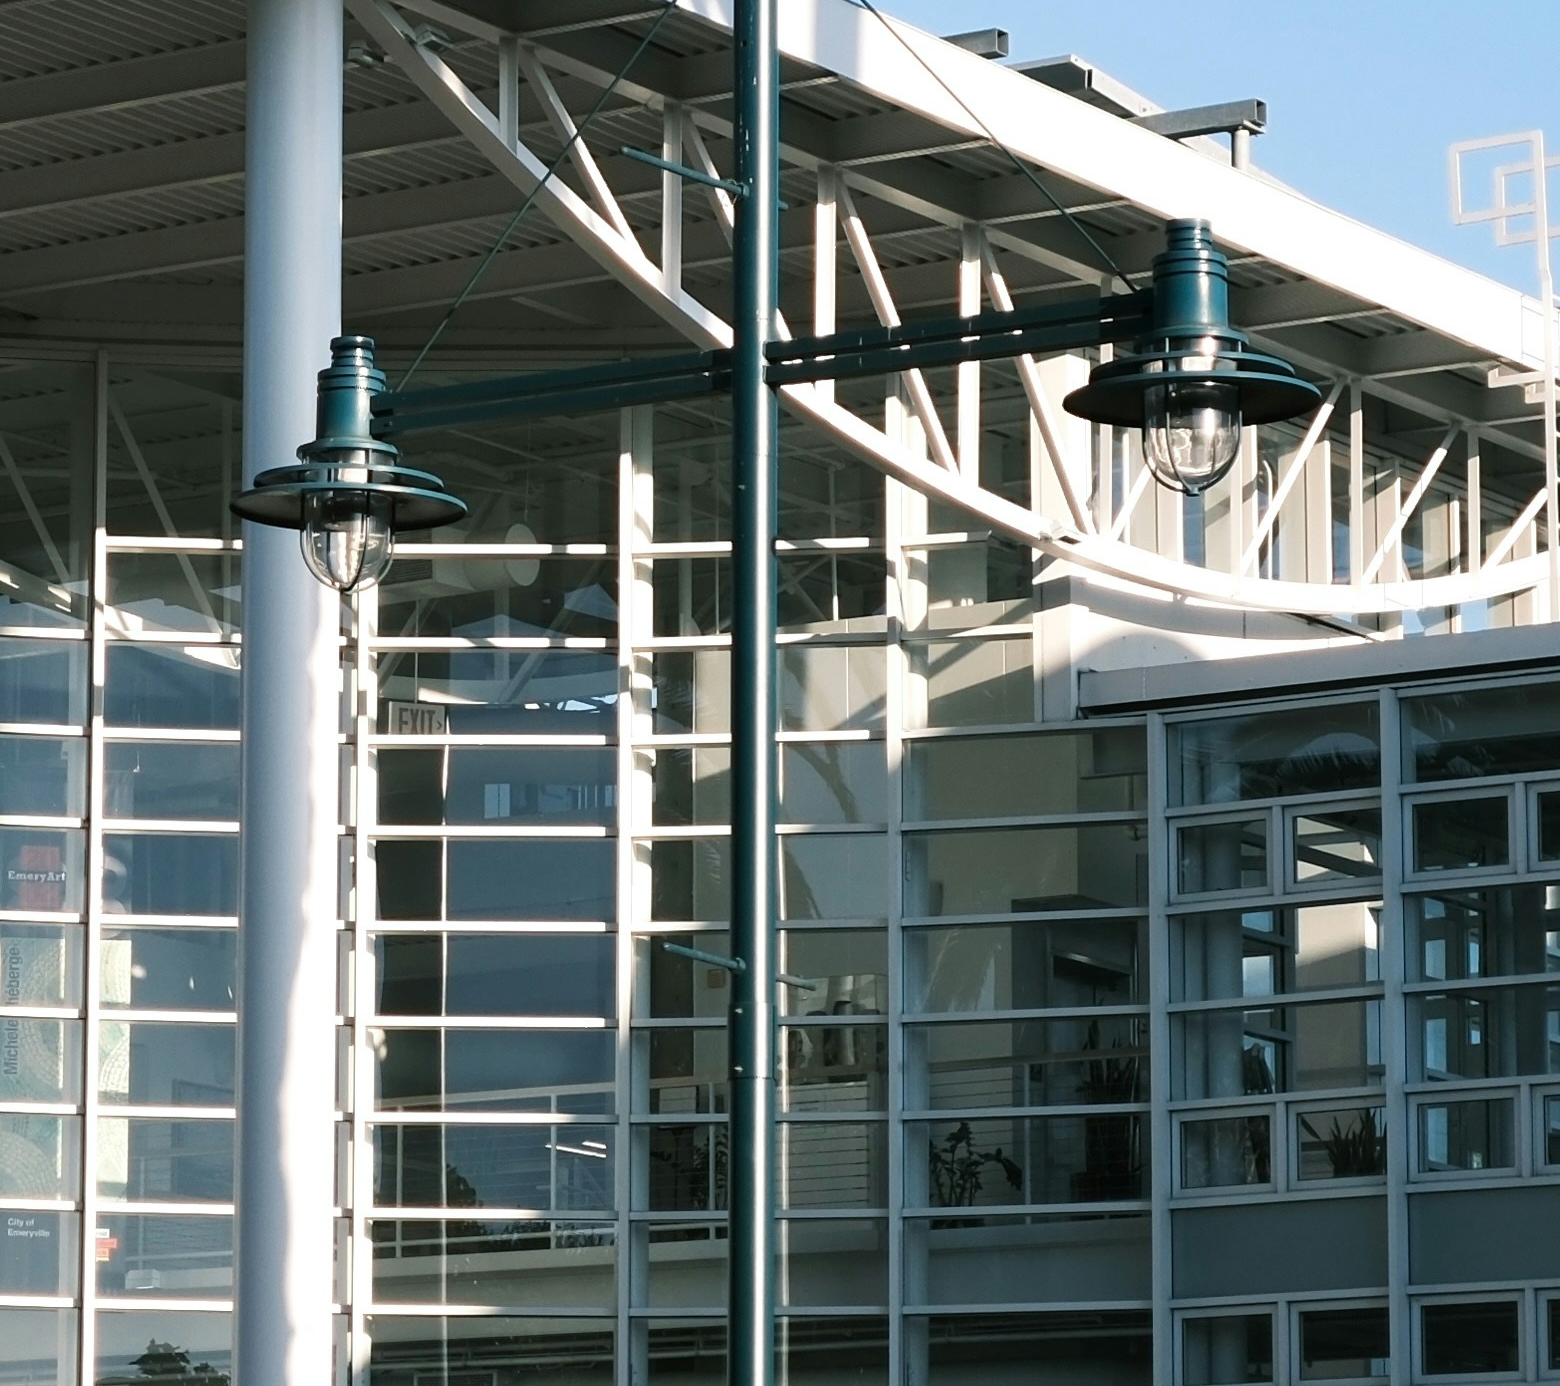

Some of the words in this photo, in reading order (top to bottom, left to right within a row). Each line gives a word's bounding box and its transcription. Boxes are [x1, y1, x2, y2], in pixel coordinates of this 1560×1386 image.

[399, 708, 436, 734] EXIT
[4, 1019, 19, 1075] Michele
[8, 1218, 24, 1227] City
[8, 1229, 50, 1238] Emeryville
